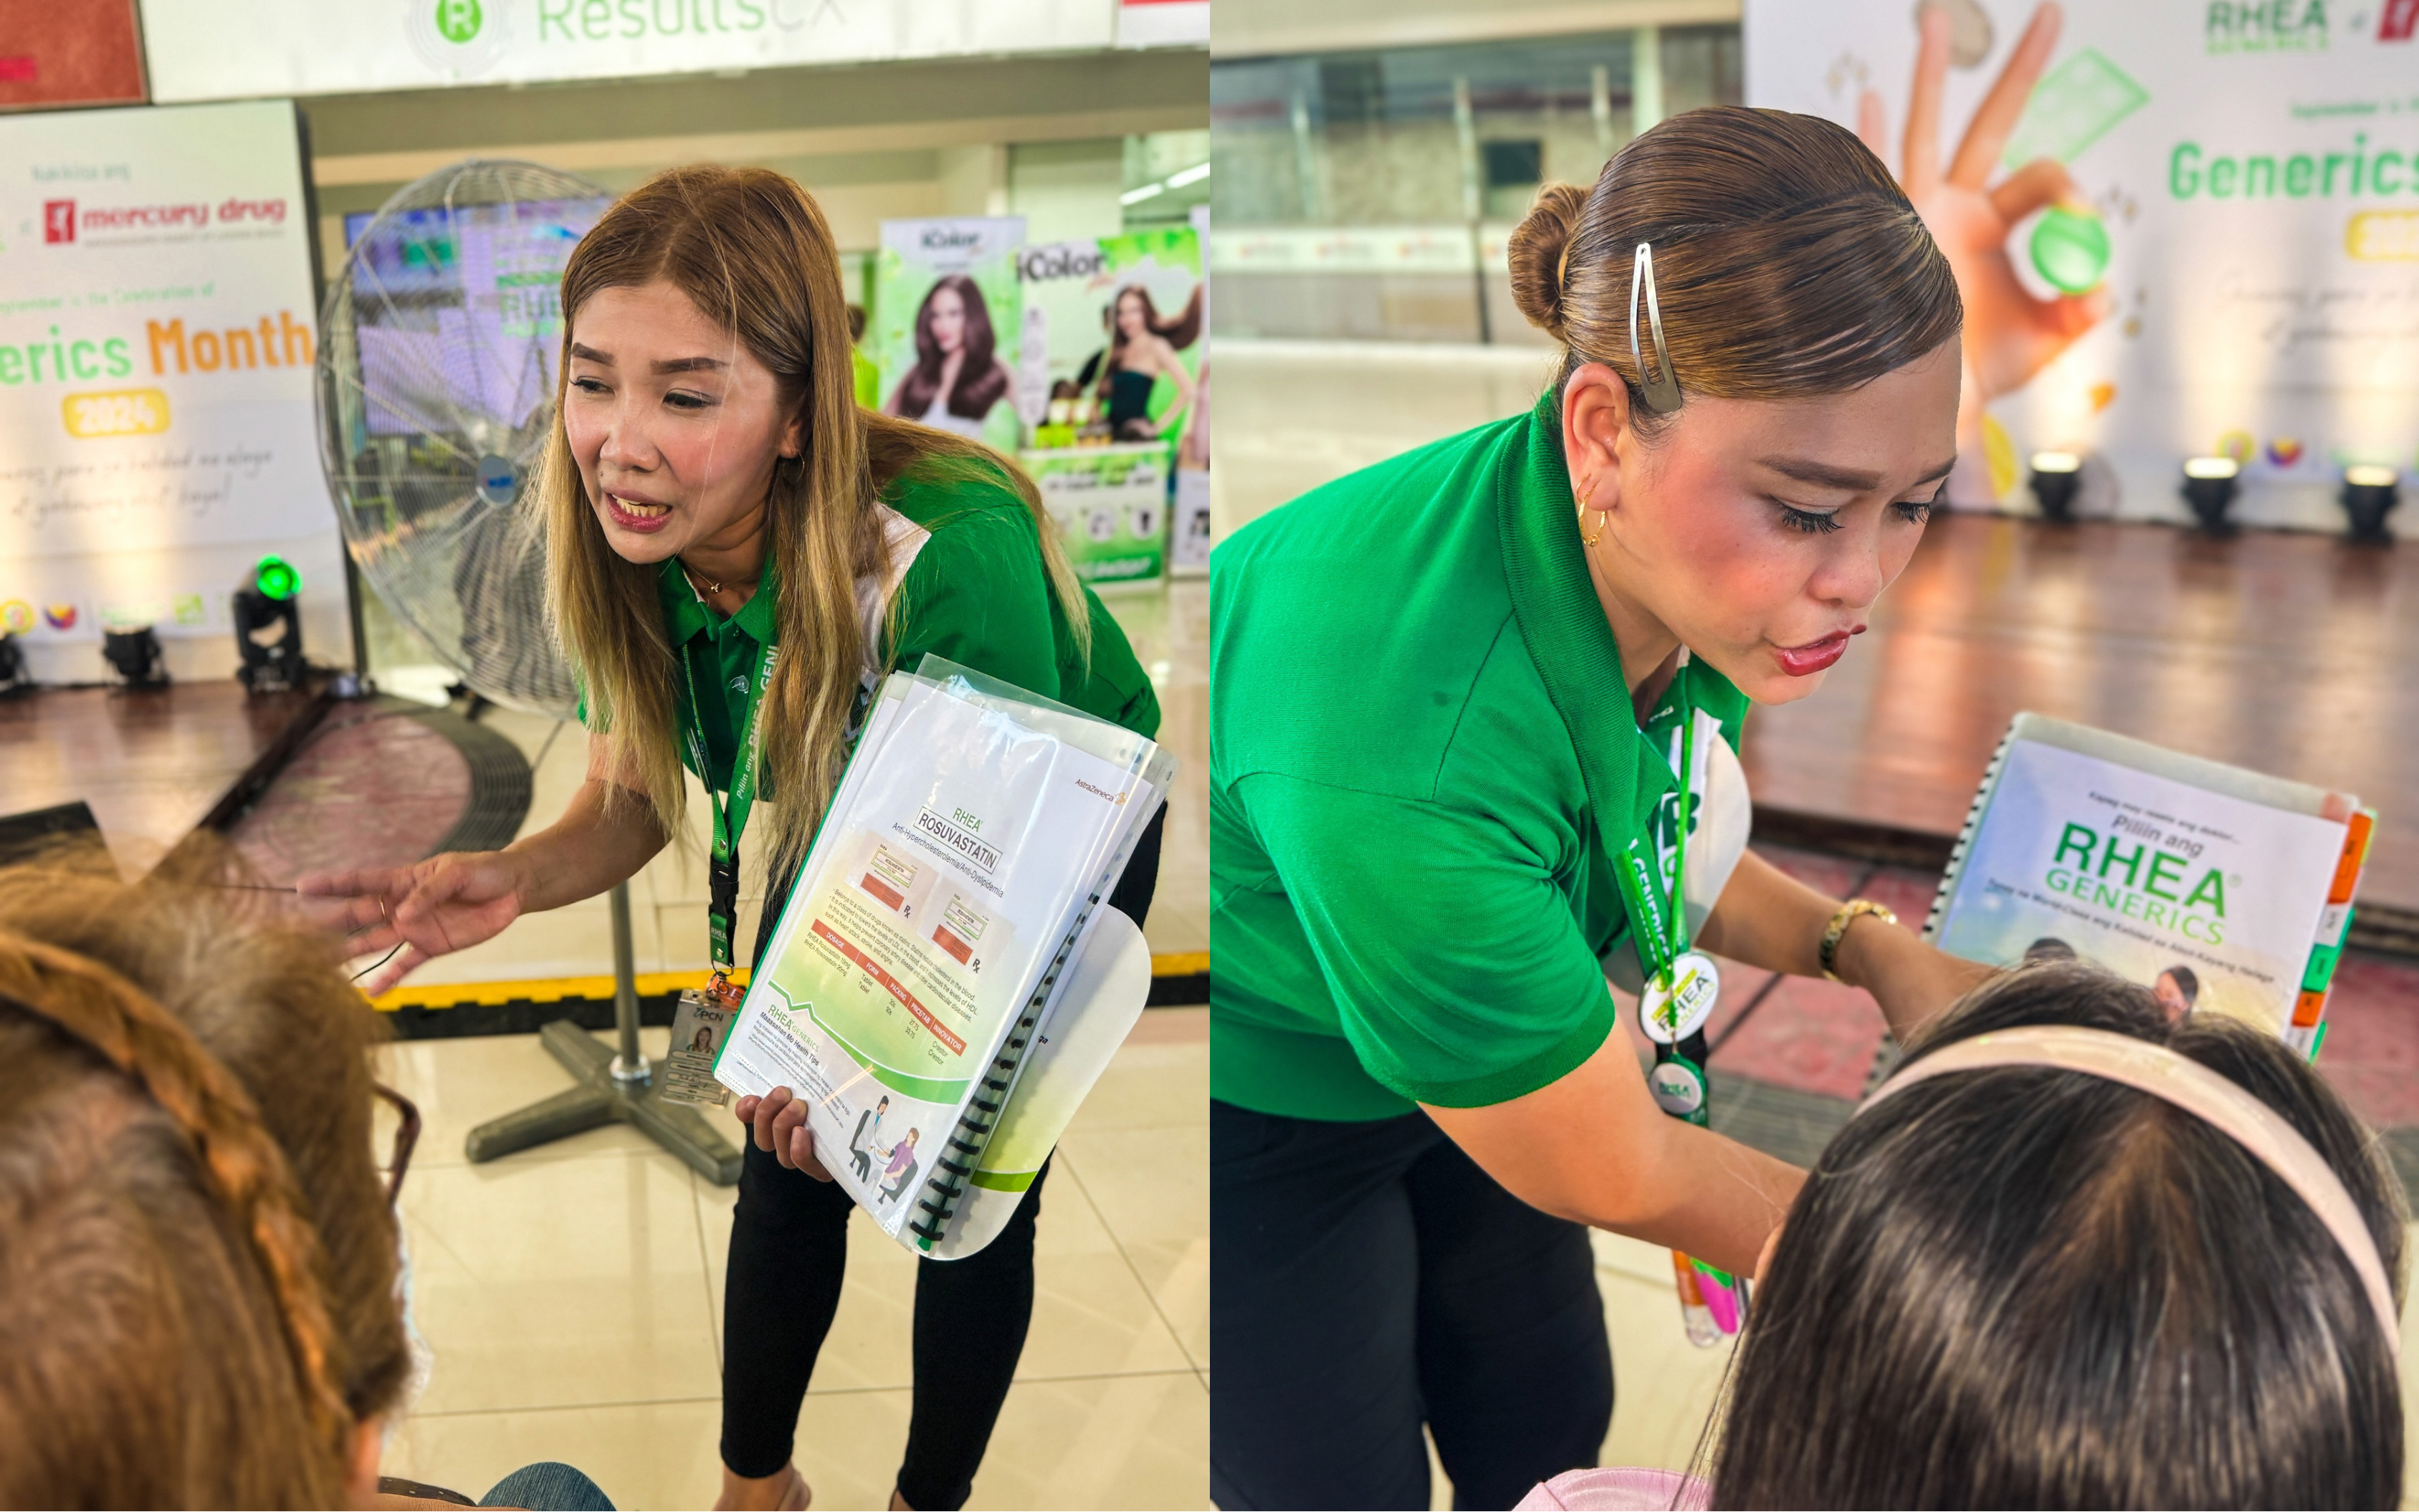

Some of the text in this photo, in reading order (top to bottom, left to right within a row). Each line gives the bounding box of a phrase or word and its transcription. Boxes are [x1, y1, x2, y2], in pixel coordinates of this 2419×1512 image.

[2169, 133, 2419, 199] Generic
[83, 196, 286, 229] mercury drug
[1015, 251, 1104, 283] iColor
[0, 310, 315, 386] erics Month
[75, 395, 157, 434] 2024
[736, 773, 748, 800] Piliin
[1074, 777, 1115, 803] AstraZeneca
[917, 810, 998, 869] ROSUVASTATIN
[2110, 813, 2205, 861] Piliin ang
[834, 888, 849, 904] Belongs
[869, 914, 882, 927] drugs
[881, 922, 894, 935] known
[2045, 866, 2227, 946] GENERICS
[710, 927, 727, 940] RHEA
[806, 931, 819, 944] RHEA
[817, 939, 841, 961] Rosuvastatin
[860, 973, 874, 987] Tablet
[930, 1040, 949, 1058] Crestor
[825, 931, 963, 1051] DOSAGE FORM PACKING PRICE/TAB INNOVATOR
[948, 987, 962, 1003] levels
[960, 997, 967, 1007] of
[758, 1011, 788, 1036] Maaasahan
[785, 1033, 795, 1043] Mo
[792, 1040, 810, 1056] Health
[806, 1053, 821, 1066] Tips
[790, 1025, 821, 1052] GENERICS
[857, 981, 870, 995] Tablet
[927, 1048, 945, 1066] Crestor
